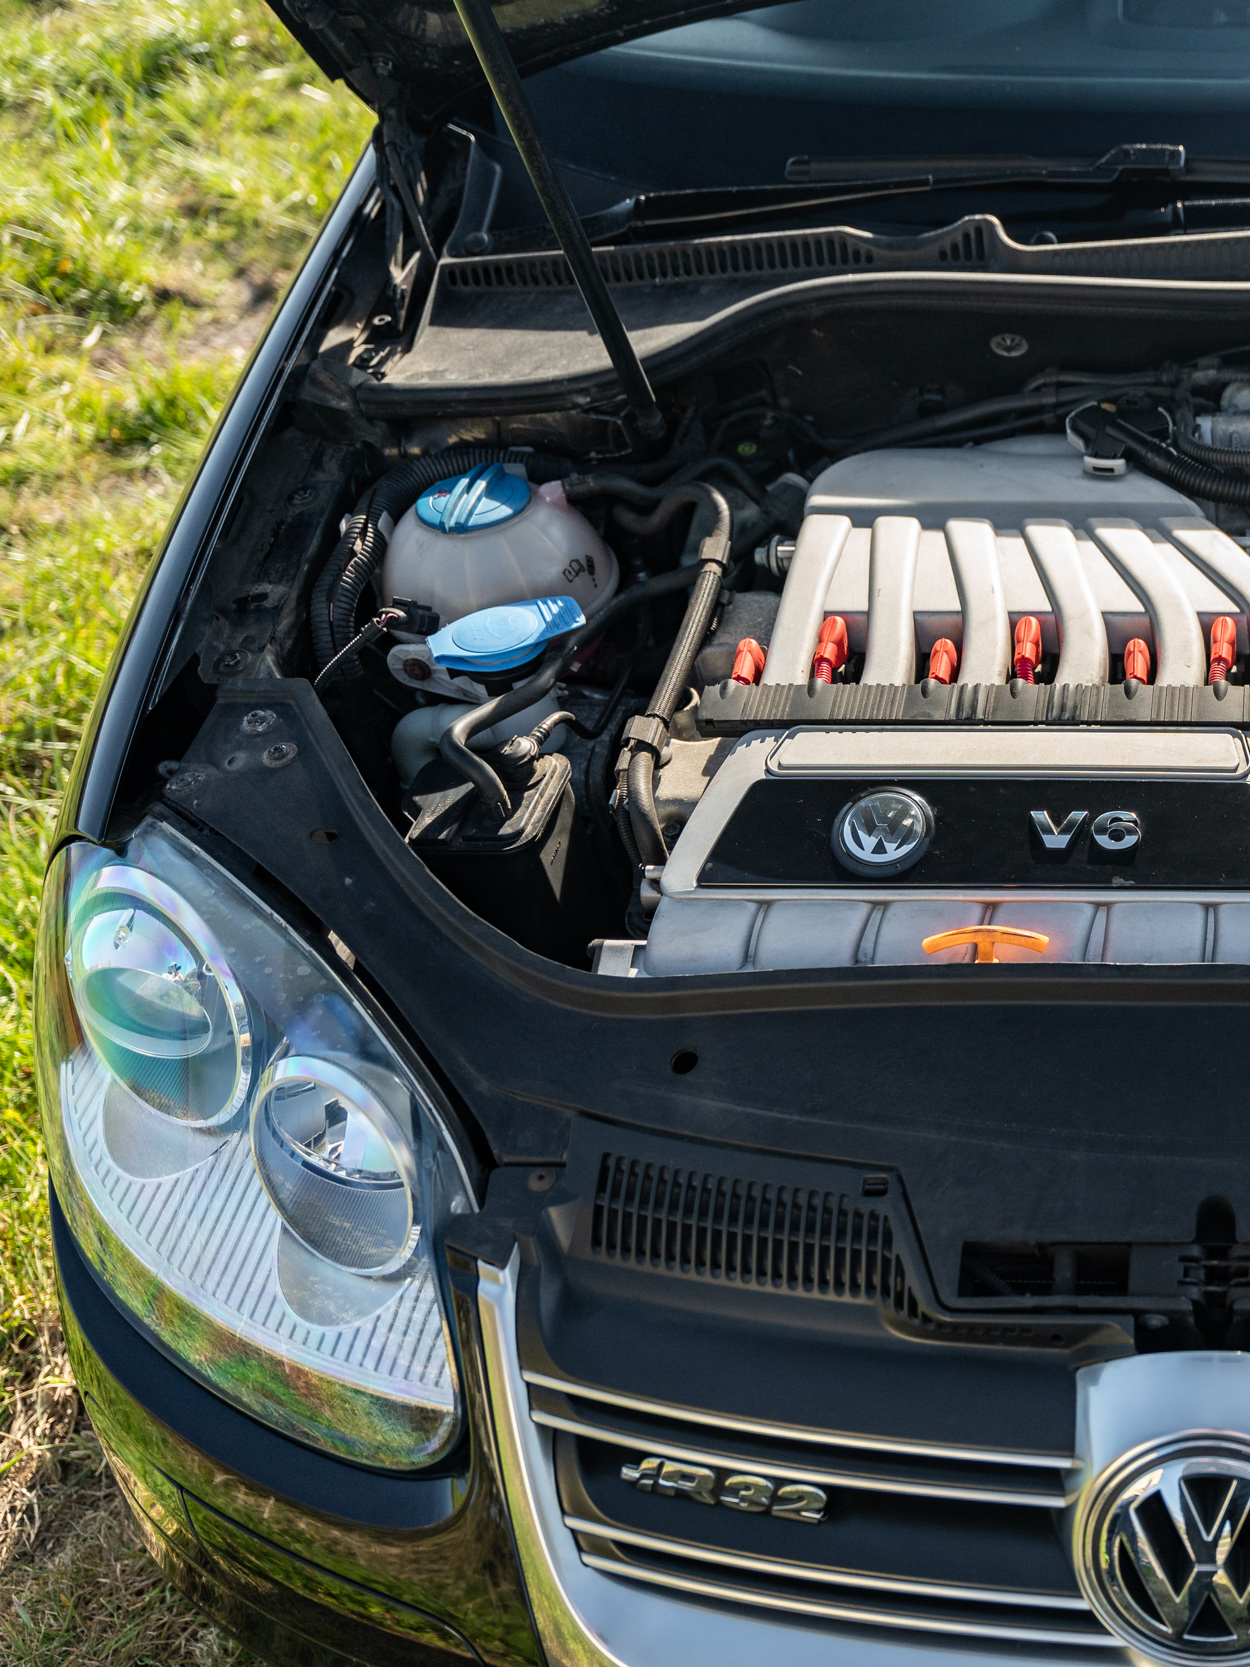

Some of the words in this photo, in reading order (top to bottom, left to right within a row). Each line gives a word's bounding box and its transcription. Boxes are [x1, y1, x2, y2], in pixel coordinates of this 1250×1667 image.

[843, 791, 926, 864] VW
[1030, 810, 1142, 850] V6
[658, 1458, 830, 1524] R32
